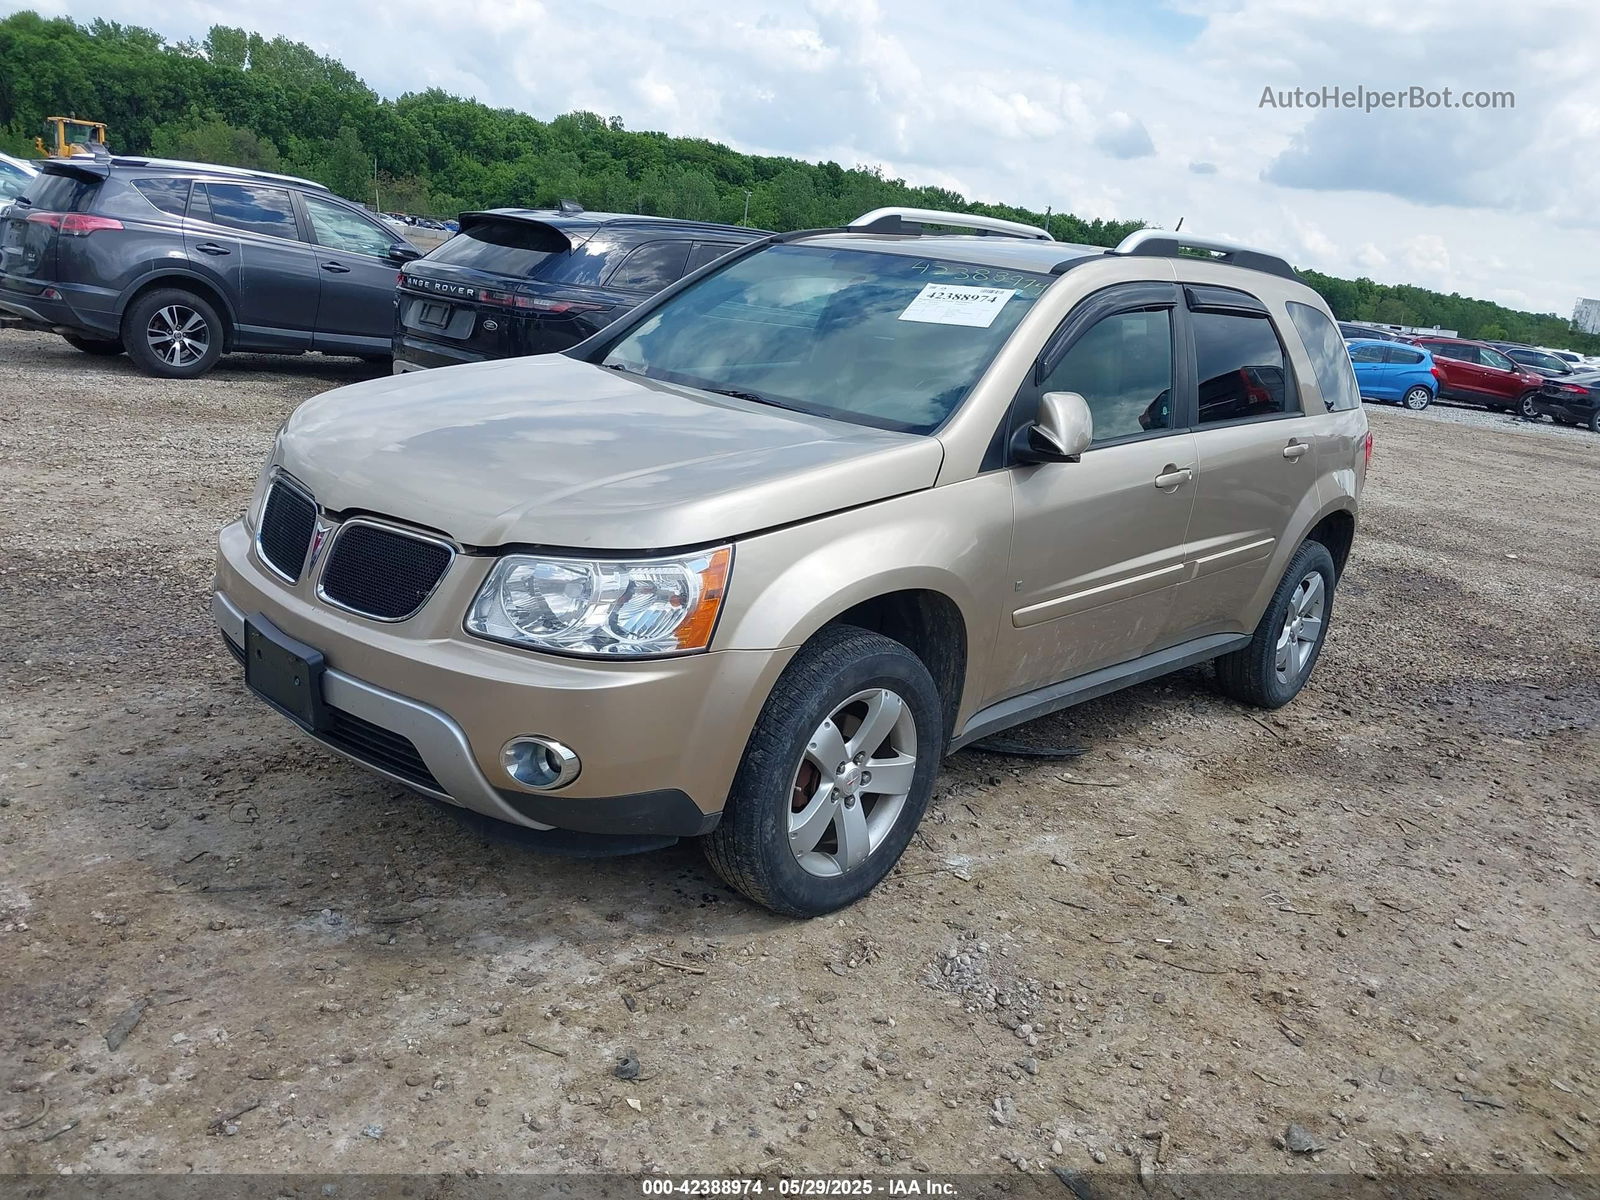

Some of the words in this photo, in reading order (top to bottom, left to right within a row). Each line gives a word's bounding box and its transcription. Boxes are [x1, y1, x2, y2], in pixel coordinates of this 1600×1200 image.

[406, 277, 430, 288] ANGE
[434, 283, 474, 296] ROVER
[911, 260, 1050, 296] 42388974
[926, 291, 999, 303] 42388974
